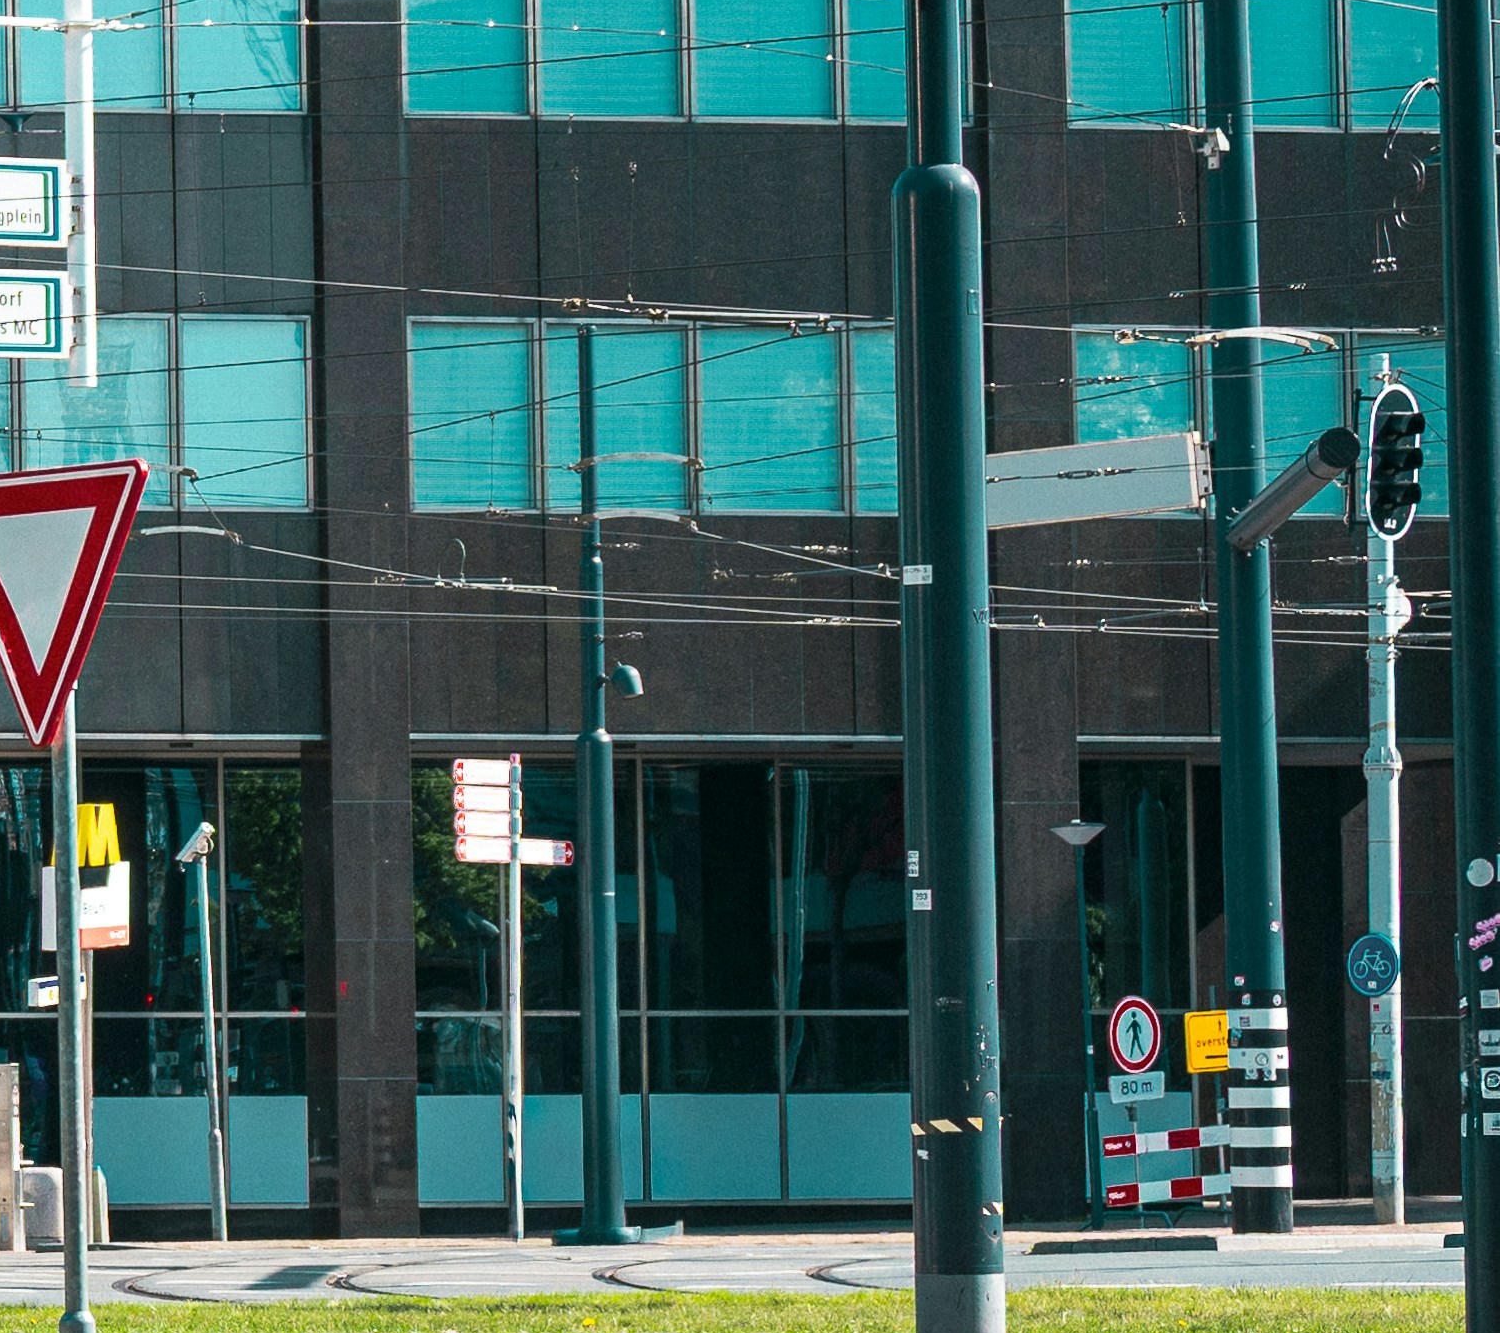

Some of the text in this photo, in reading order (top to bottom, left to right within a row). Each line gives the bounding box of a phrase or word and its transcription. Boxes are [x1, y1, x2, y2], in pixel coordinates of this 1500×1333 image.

[13, 318, 39, 337] MC
[1121, 1080, 1153, 1096] 80 m
